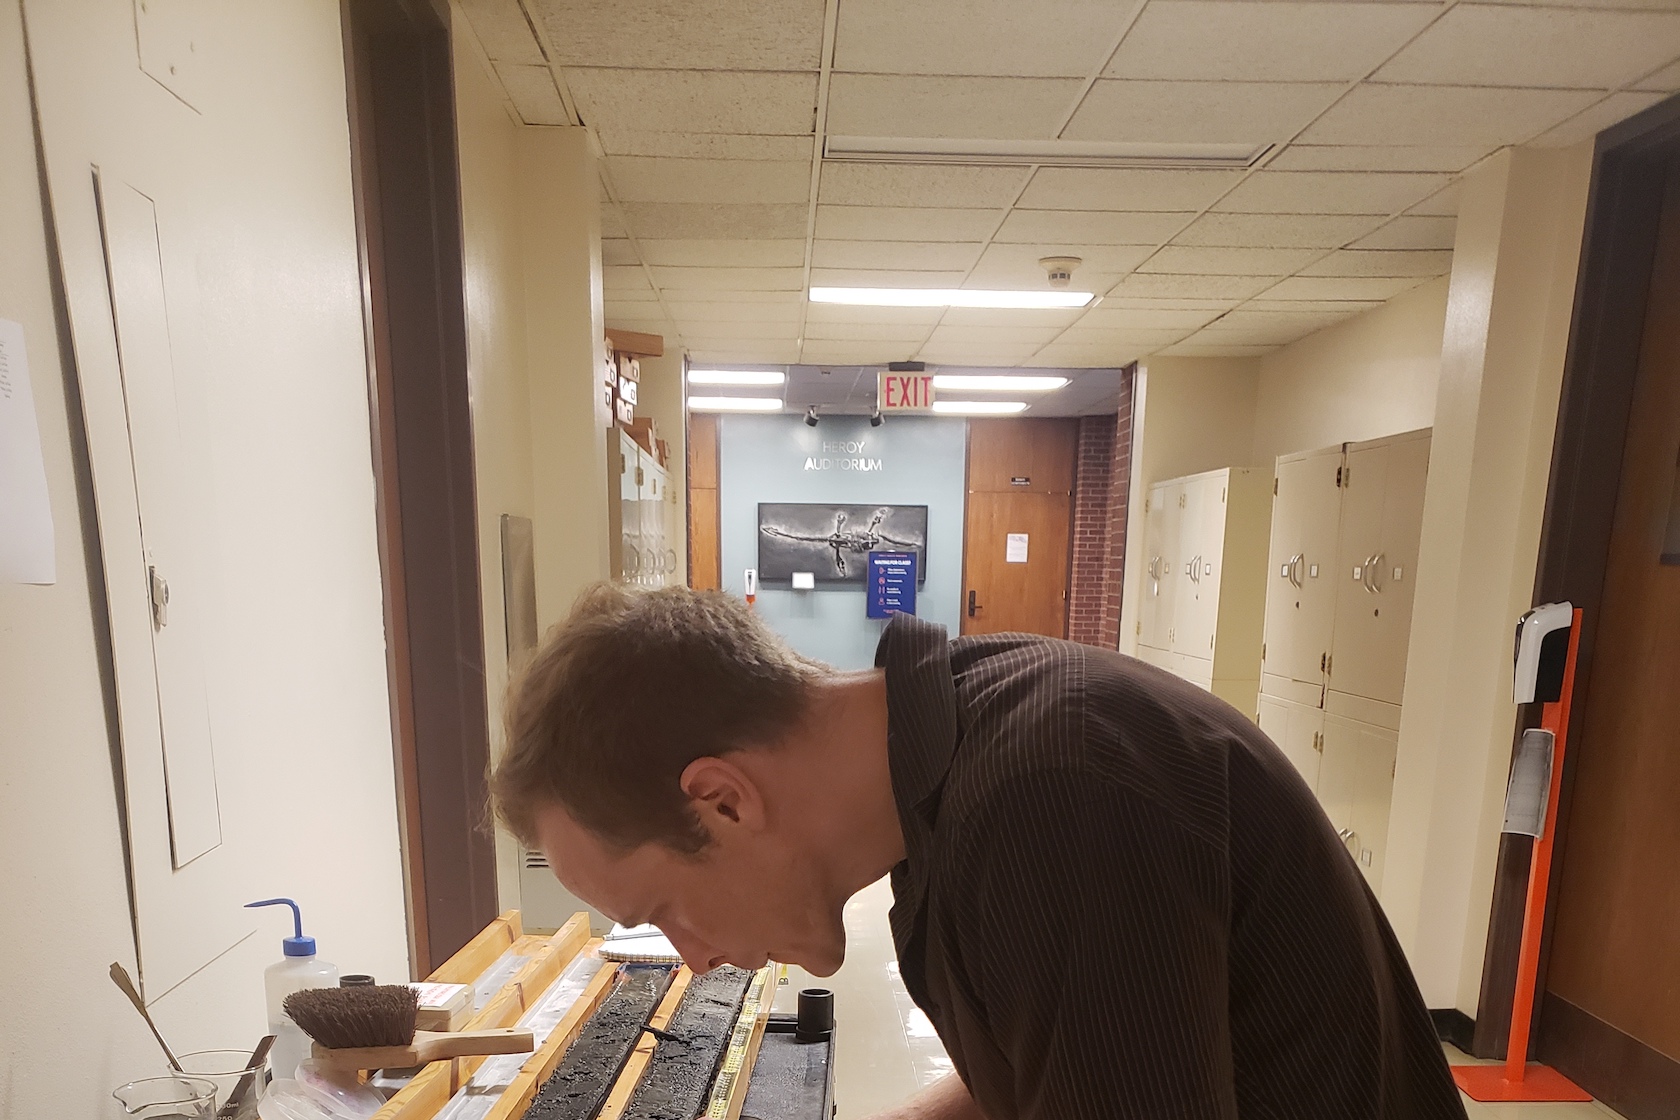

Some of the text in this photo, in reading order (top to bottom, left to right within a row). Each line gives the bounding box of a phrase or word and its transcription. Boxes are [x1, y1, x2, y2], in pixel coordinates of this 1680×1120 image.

[886, 376, 932, 407] EXIT
[822, 441, 865, 454] HEROY
[803, 457, 883, 471] AUDITORIUM
